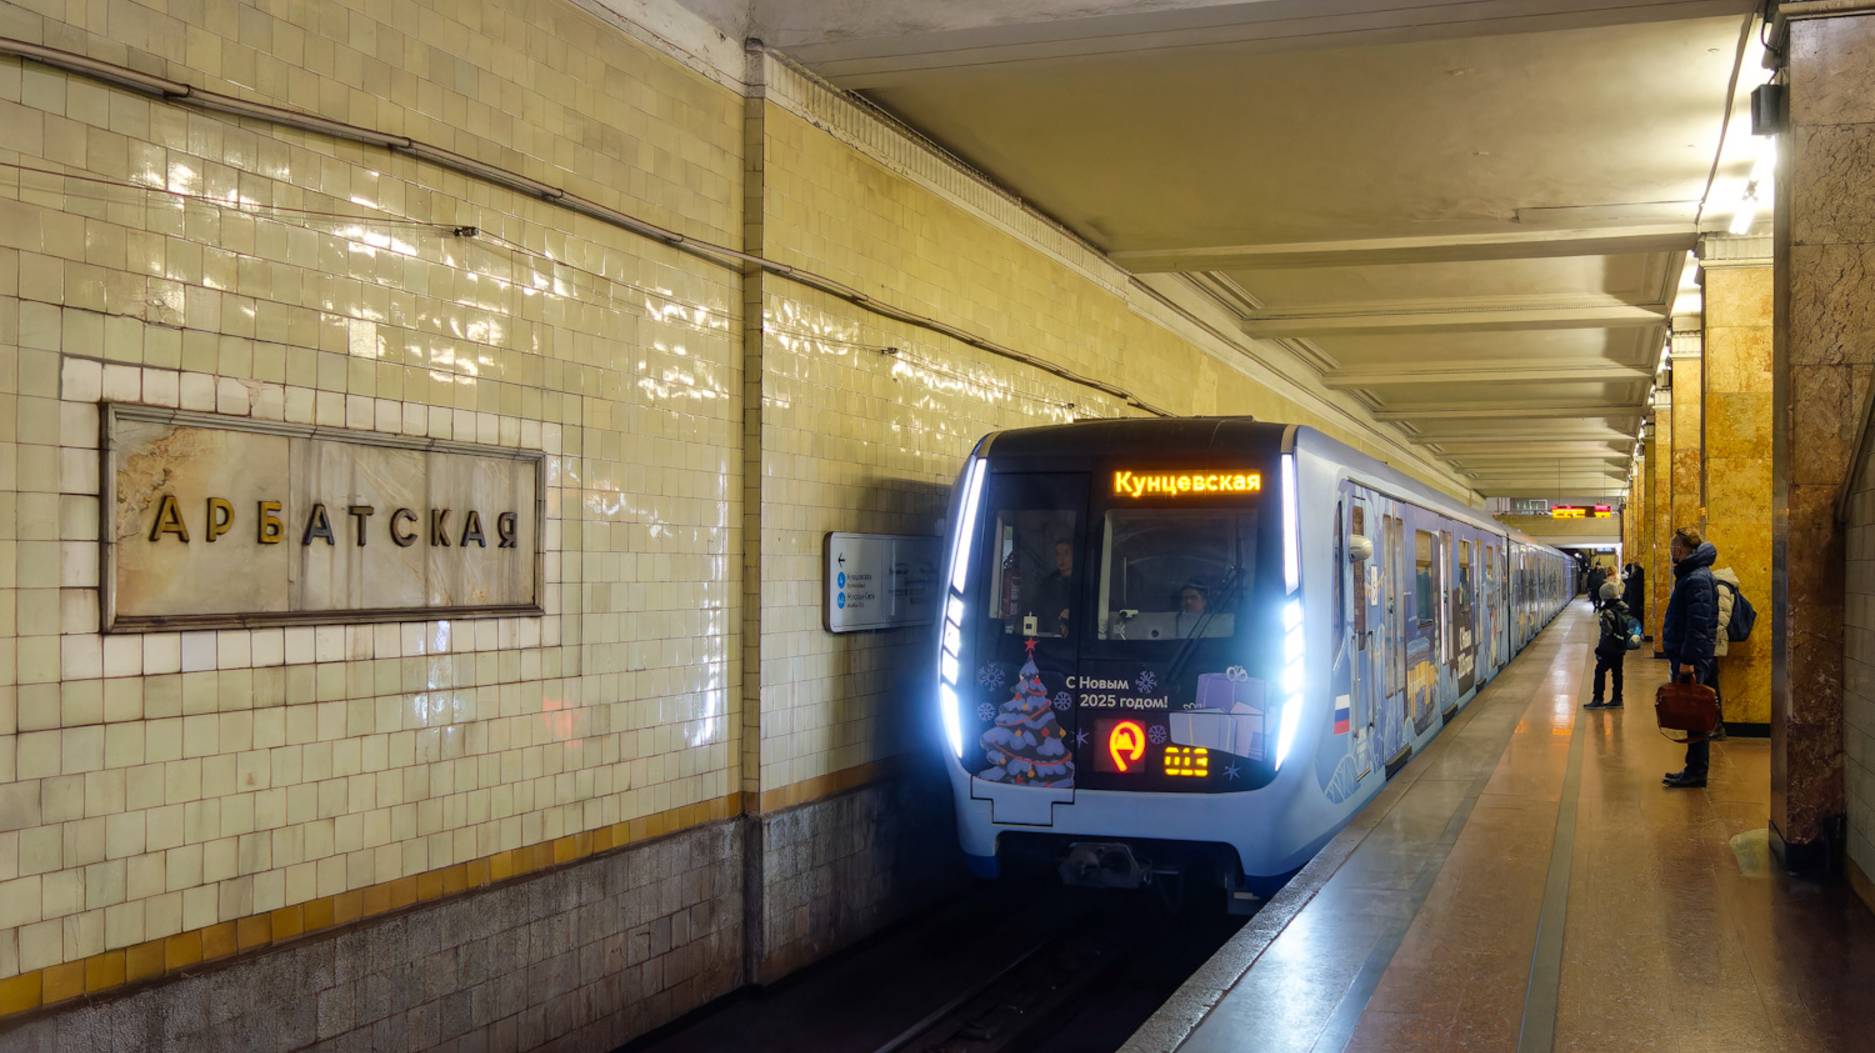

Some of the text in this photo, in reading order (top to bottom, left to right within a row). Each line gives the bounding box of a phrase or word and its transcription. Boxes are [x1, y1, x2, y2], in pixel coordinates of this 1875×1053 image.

[1114, 471, 1261, 498] Кунцевская
[148, 494, 518, 549] АРБАТСКАЯ
[1065, 676, 1129, 690] С Новым
[1080, 694, 1169, 709] 2025 годом!
